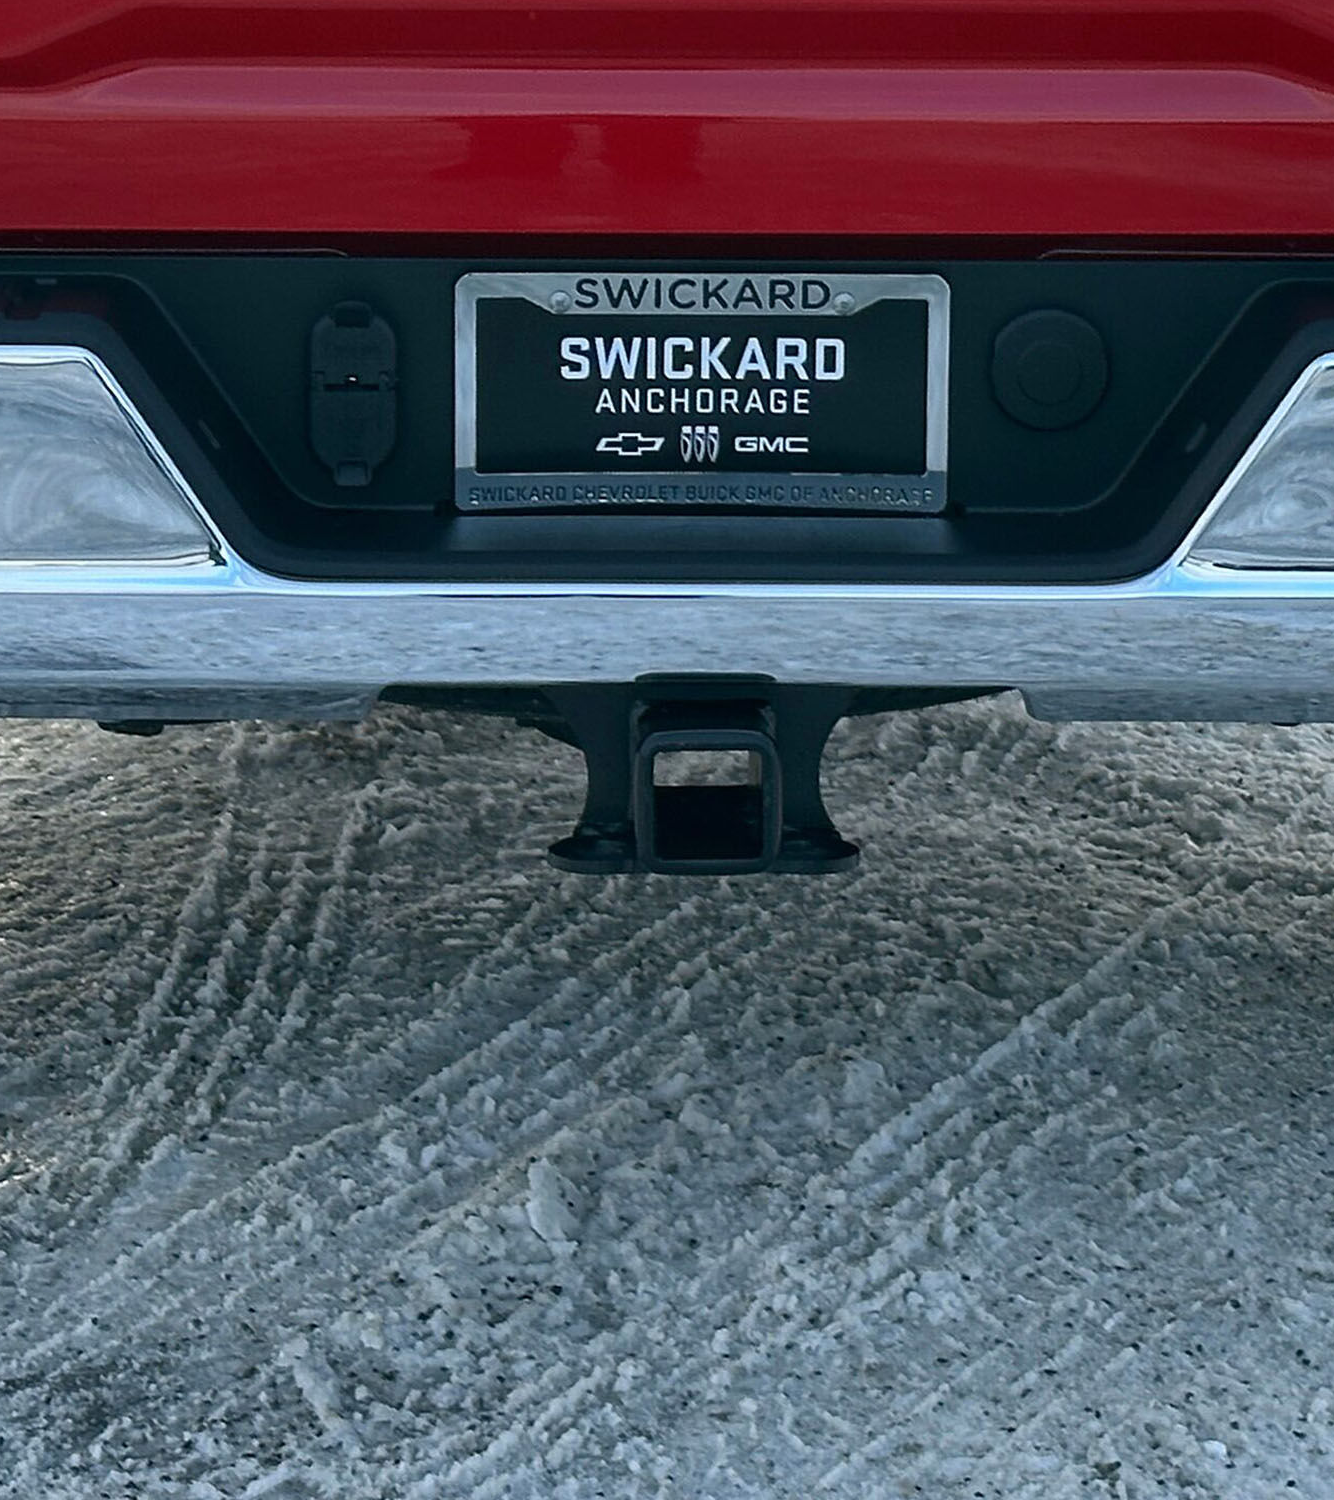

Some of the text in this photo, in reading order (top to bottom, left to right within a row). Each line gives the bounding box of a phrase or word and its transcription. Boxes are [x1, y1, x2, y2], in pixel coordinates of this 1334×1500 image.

[572, 277, 833, 312] SWICKARD
[559, 336, 846, 382] SWICKARD
[594, 388, 811, 415] ANCHORAGE
[734, 436, 810, 454] GMC
[468, 486, 567, 506] SWICKARD
[572, 485, 678, 504] CHEVROLET
[685, 485, 740, 503] BUICK
[744, 485, 785, 503] GMC
[790, 485, 815, 502] OF
